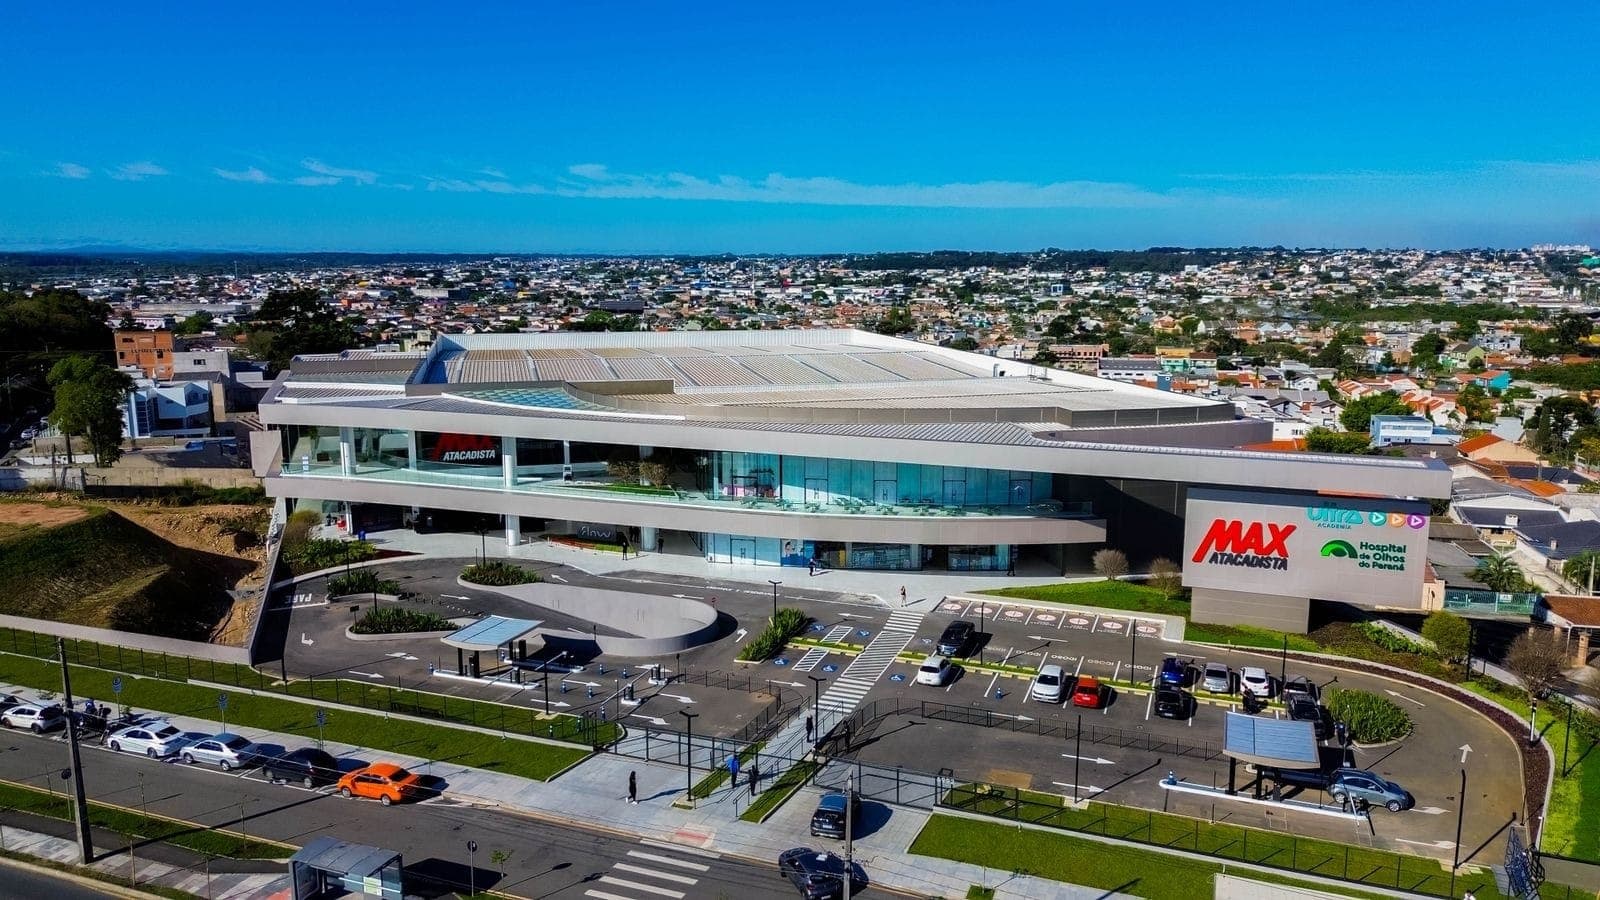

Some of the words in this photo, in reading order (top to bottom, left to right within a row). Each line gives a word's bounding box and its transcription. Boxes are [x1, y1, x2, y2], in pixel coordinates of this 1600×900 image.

[443, 449, 496, 461] ATACADISTA
[1192, 519, 1297, 563] MAX
[1359, 541, 1407, 554] Hospital
[1208, 551, 1288, 571] ATACADISTA
[1359, 552, 1371, 560] de
[1373, 552, 1405, 563] Olhos
[1358, 561, 1371, 569] do
[1372, 561, 1405, 572] Paraná
